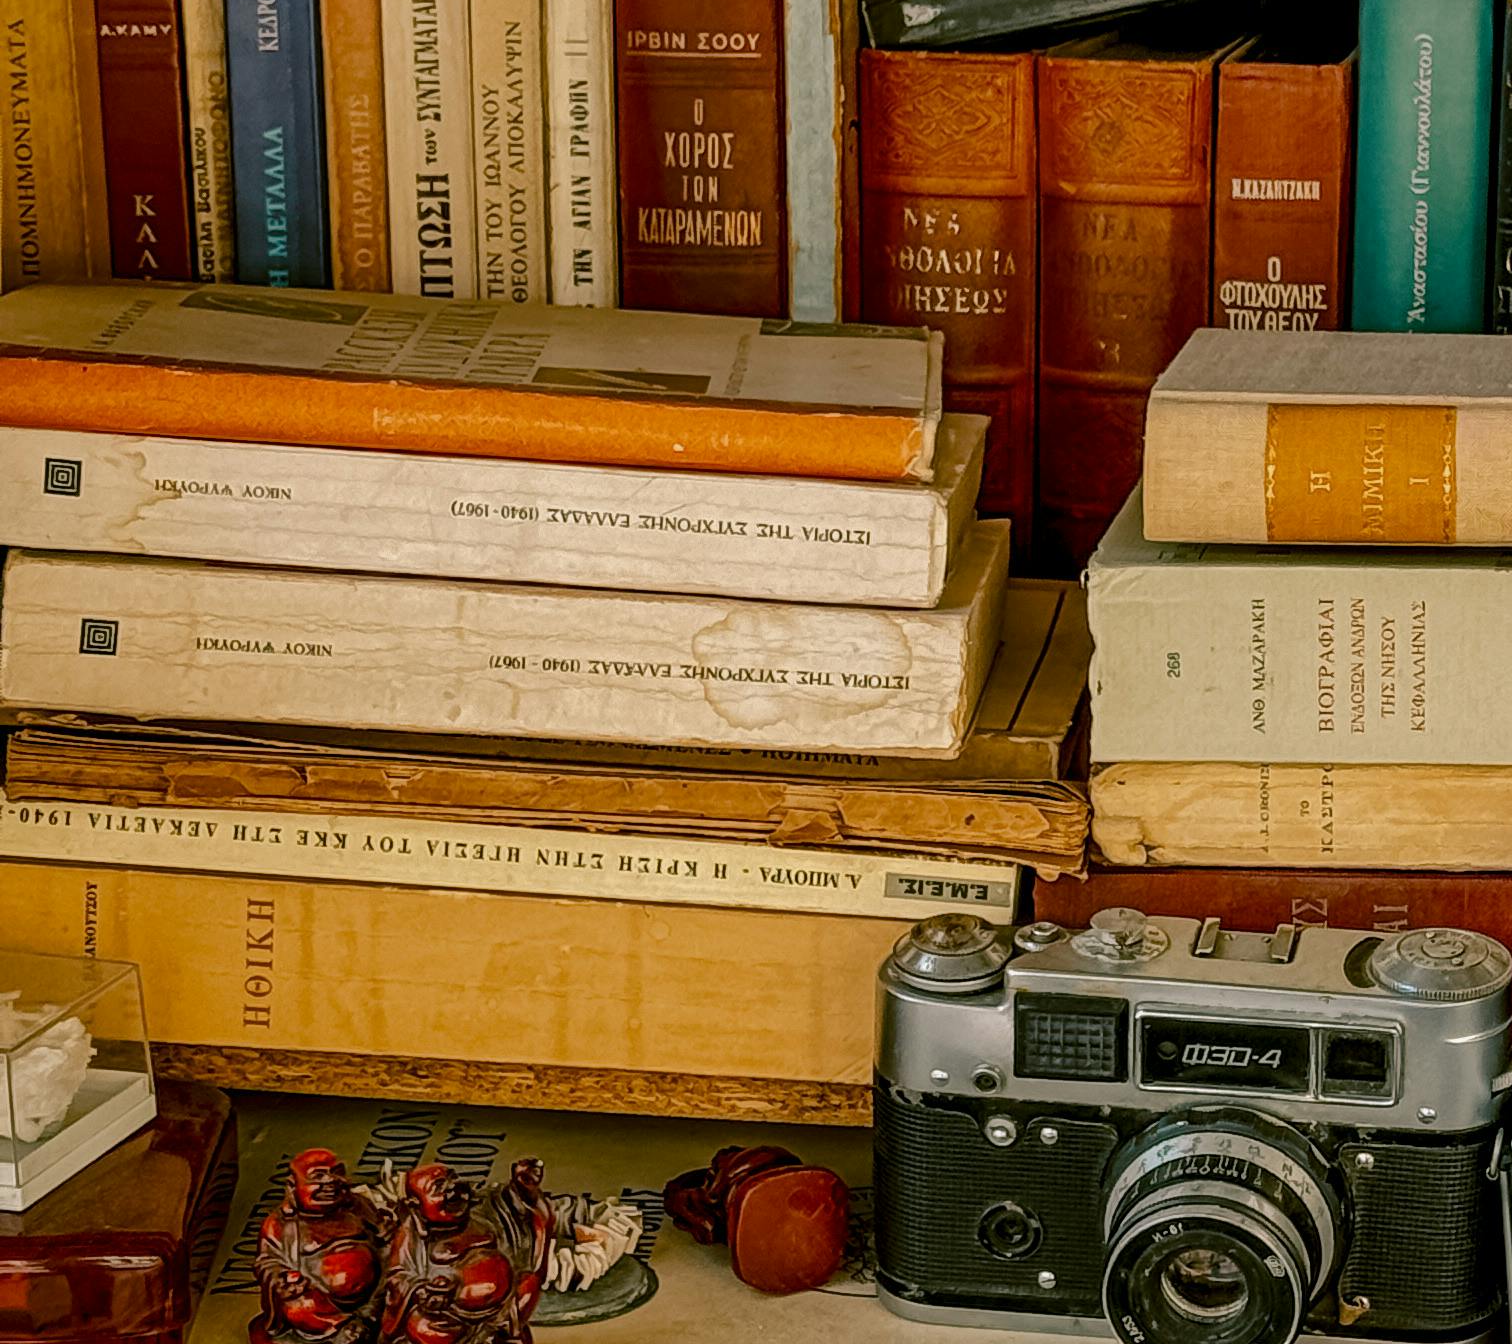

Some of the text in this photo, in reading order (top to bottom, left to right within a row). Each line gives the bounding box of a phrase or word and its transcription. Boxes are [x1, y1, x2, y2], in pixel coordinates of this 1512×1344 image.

[627, 31, 759, 52] ΙΡΒΙΝ ΣΟΟΥ
[694, 100, 704, 125] Ο
[664, 131, 734, 168] ΧΟΡΟΣ
[266, 127, 289, 258] ΜΕΤΑΛΛΑ
[682, 176, 719, 202] ΤΩΝ
[418, 174, 453, 299] ΠΤΩΣΗ
[638, 206, 762, 248] ΚΑΤΑΡΑΜΕΝΩΝ
[1267, 256, 1280, 281] Ο
[1220, 281, 1327, 310] ΦΤΩΧΟΥΛΗΣ
[547, 509, 871, 545] ΙΣΤΟΡΙΑ ΤΗΣ ΣΥΓΧΡΟΝΗΣ ΕΛΛΑΔΑΣ
[1317, 598, 1335, 733] ΒΙΟΓΡΑΦΙΑΙ
[1410, 602, 1427, 733] ΚΕΦΑΛΛΗΝΙΑΣ
[242, 897, 275, 1030] ΗΘΙΚΗ
